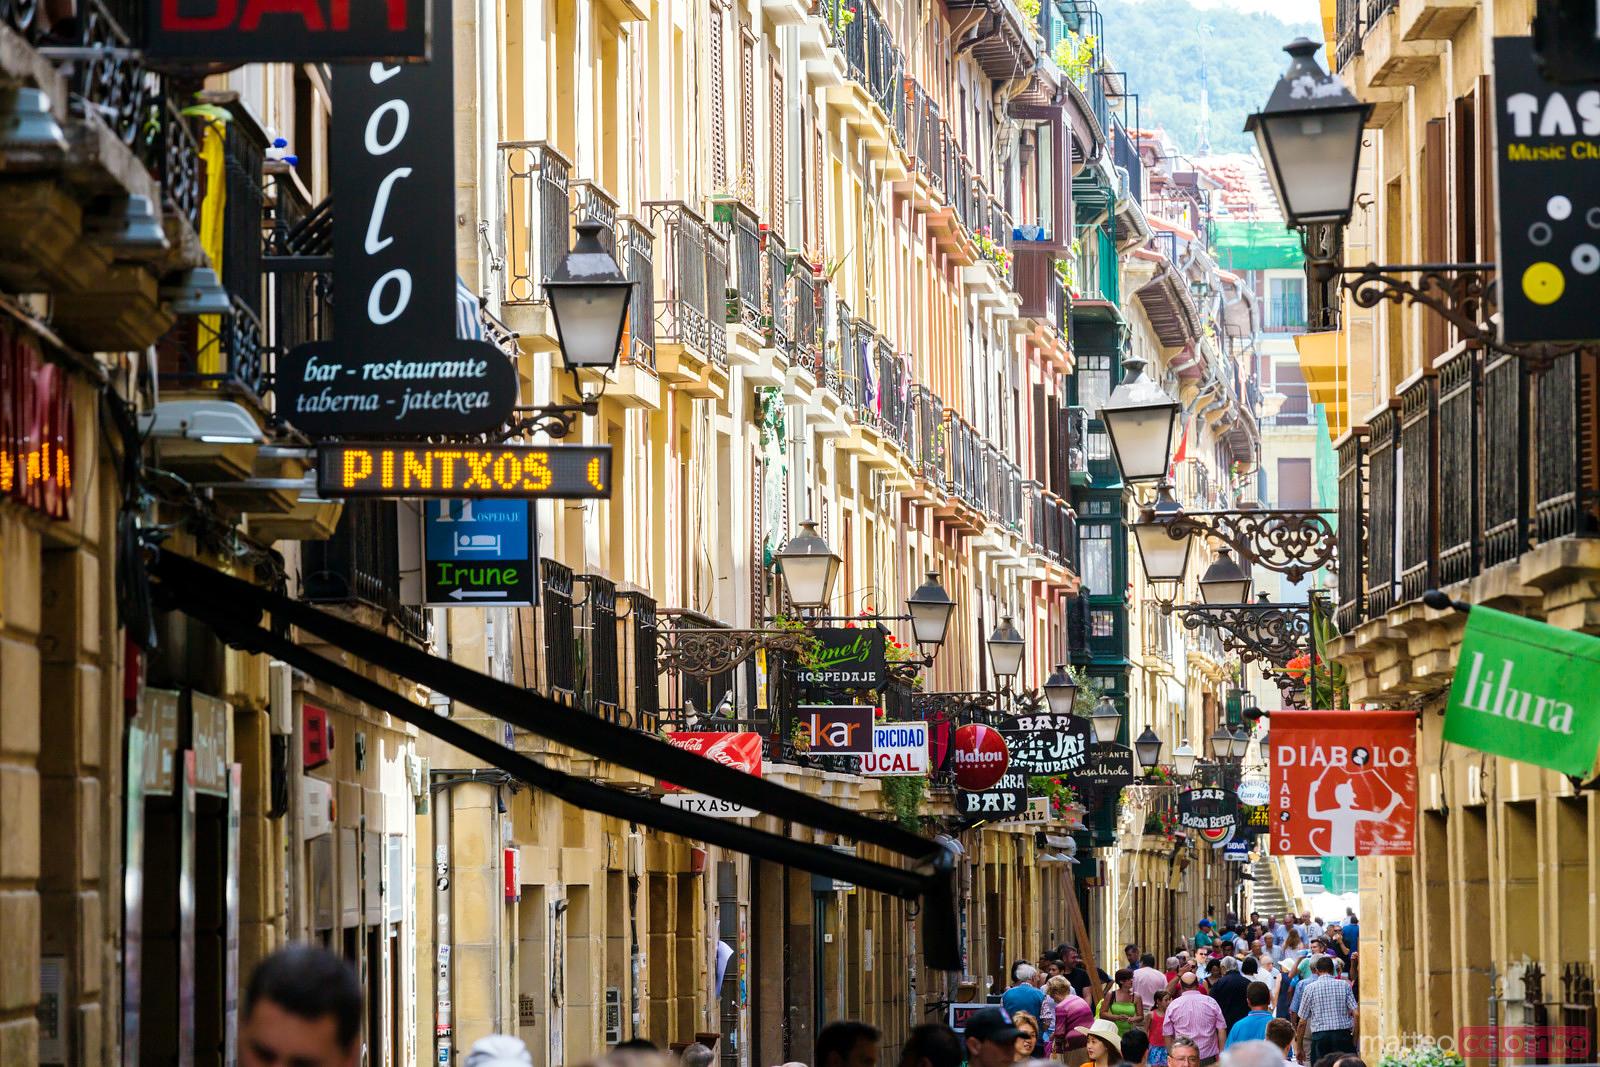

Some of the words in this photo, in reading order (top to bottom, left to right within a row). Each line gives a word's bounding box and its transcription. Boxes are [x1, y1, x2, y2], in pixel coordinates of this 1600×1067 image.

[1508, 143, 1566, 161] Music
[304, 356, 342, 382] bar
[362, 358, 488, 380] restaurante
[296, 386, 379, 413] taberna
[395, 387, 490, 420] jatetxea
[343, 450, 552, 490] PINTXOS
[437, 563, 519, 586] Irune
[797, 671, 876, 682] HOSPEDAJE
[1459, 651, 1573, 735] lilura
[800, 713, 860, 747] elkar
[1098, 763, 1130, 776] Urola
[966, 793, 1016, 812] BAR
[1191, 789, 1225, 801] BAR
[680, 800, 742, 812] ITXASO
